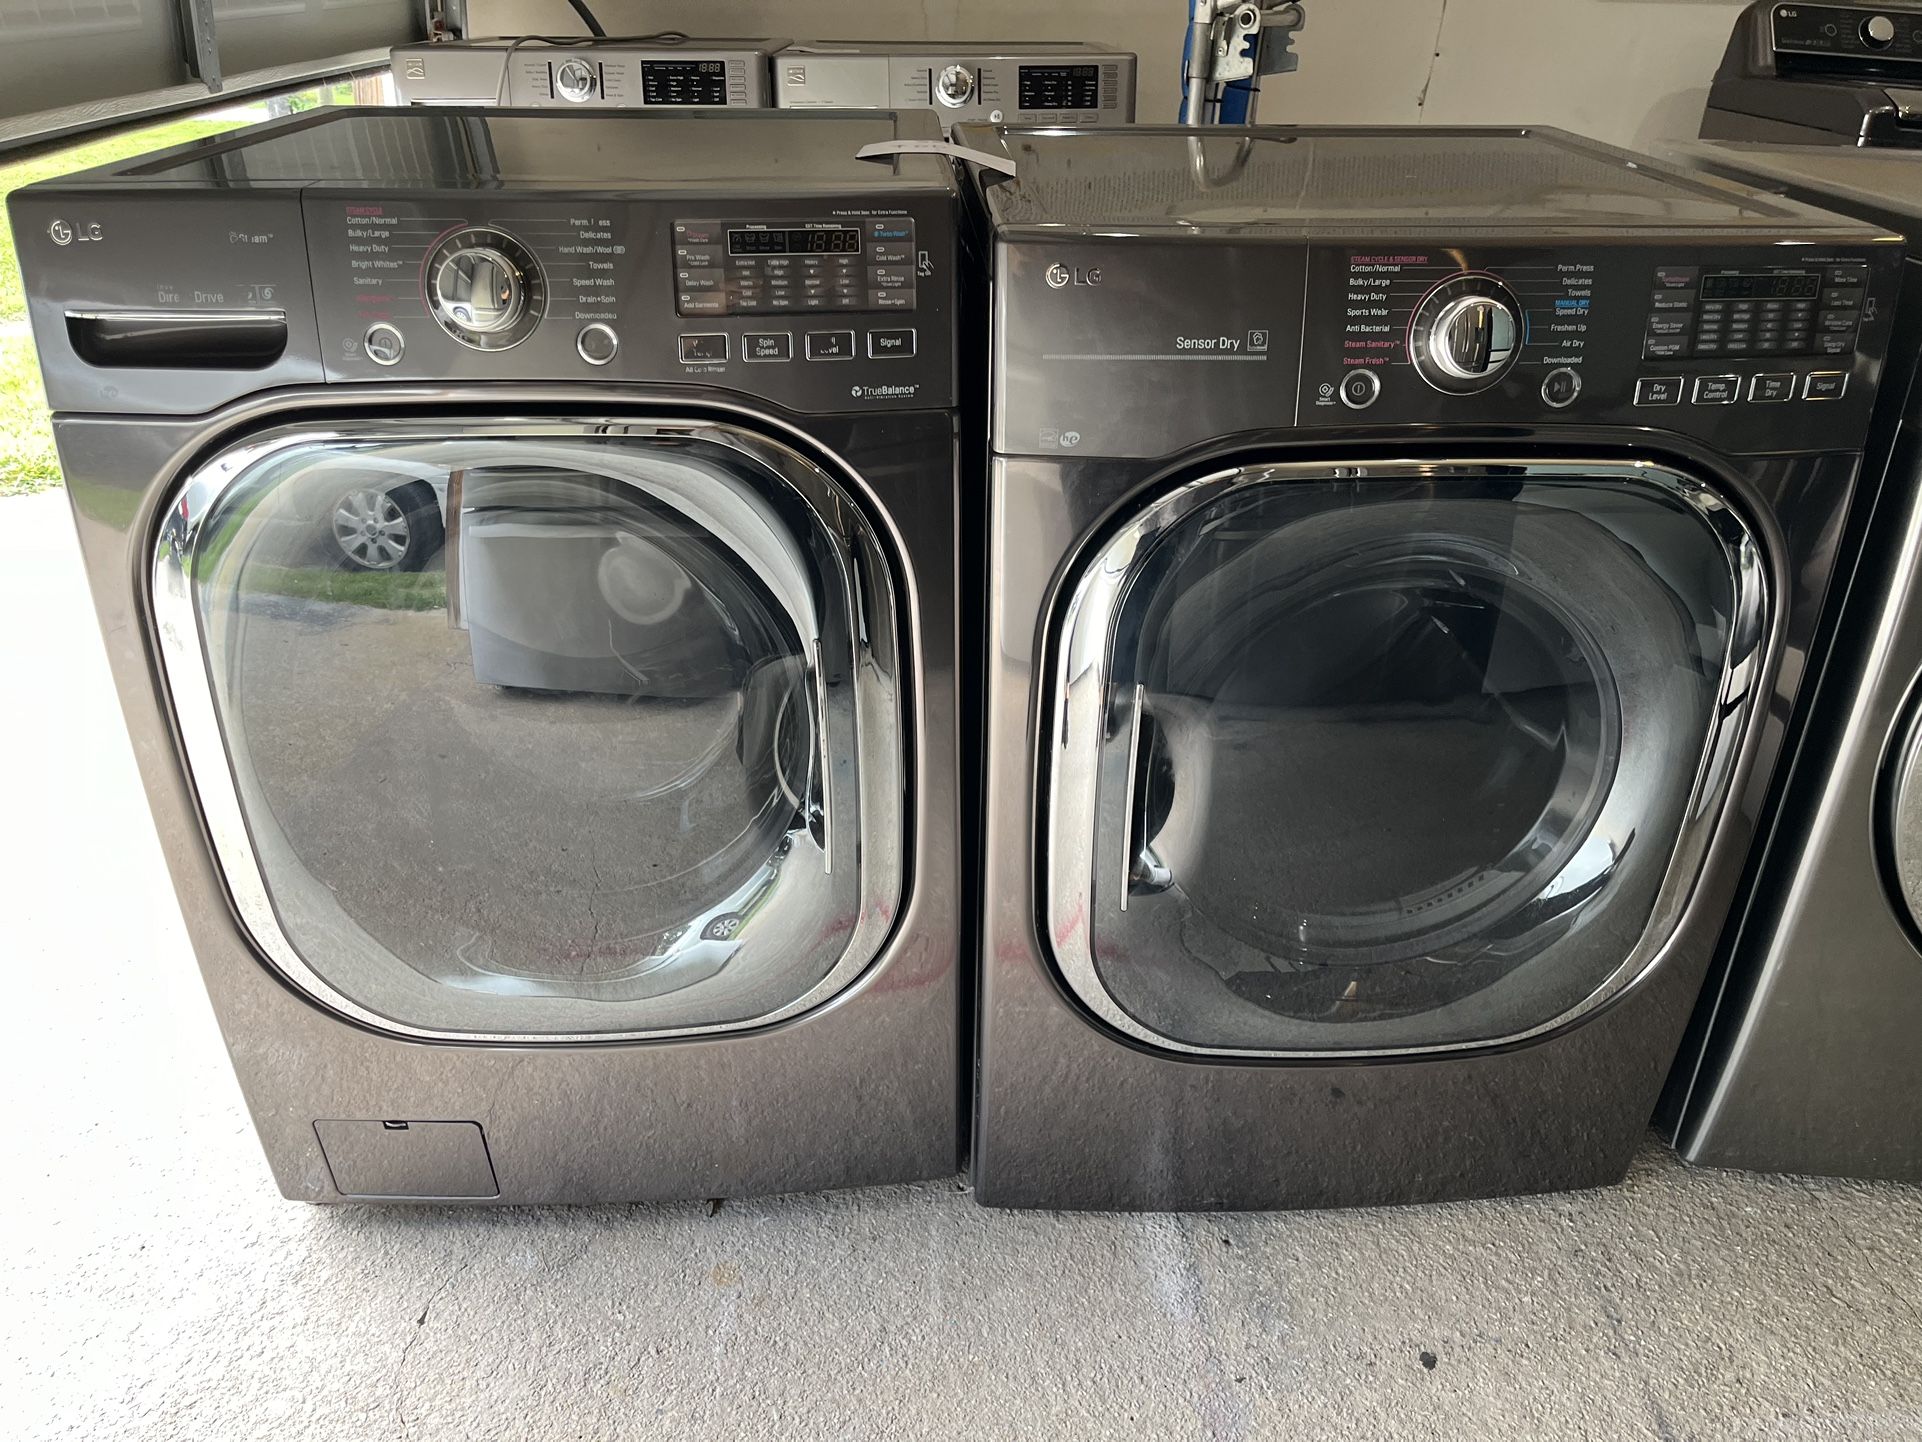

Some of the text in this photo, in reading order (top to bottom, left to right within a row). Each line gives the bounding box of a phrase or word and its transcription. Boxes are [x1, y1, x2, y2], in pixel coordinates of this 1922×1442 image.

[346, 217, 398, 225] Cotton/Normal
[77, 223, 103, 241] LG
[348, 230, 390, 238] Bulky/Large
[580, 231, 612, 239] Delicates
[350, 244, 389, 253] Heavy Duty
[559, 246, 575, 254] Hand
[352, 261, 372, 270] Bright
[588, 261, 614, 269] Towels
[1074, 267, 1102, 286] LG
[354, 277, 382, 286] Sanitary
[572, 278, 614, 288] Speed Wash
[1349, 278, 1390, 286] Bulky/Large
[194, 291, 224, 303] Drive
[1348, 293, 1386, 301] Heavy Duty
[1347, 308, 1389, 317] Sports Wear
[1556, 308, 1588, 316] Speed Dry
[758, 338, 774, 348] Spin
[880, 338, 902, 348] Signal
[1176, 337, 1240, 351] Sensor Dry
[1573, 340, 1584, 348] Dry
[756, 347, 778, 356] Speed
[1654, 384, 1666, 393] Dry
[1708, 383, 1726, 391] Temp.
[1766, 380, 1781, 388] Time
[1816, 382, 1836, 391] Signal
[1649, 392, 1668, 400] Level
[1704, 390, 1728, 399] Control
[1766, 389, 1776, 398] Dry
